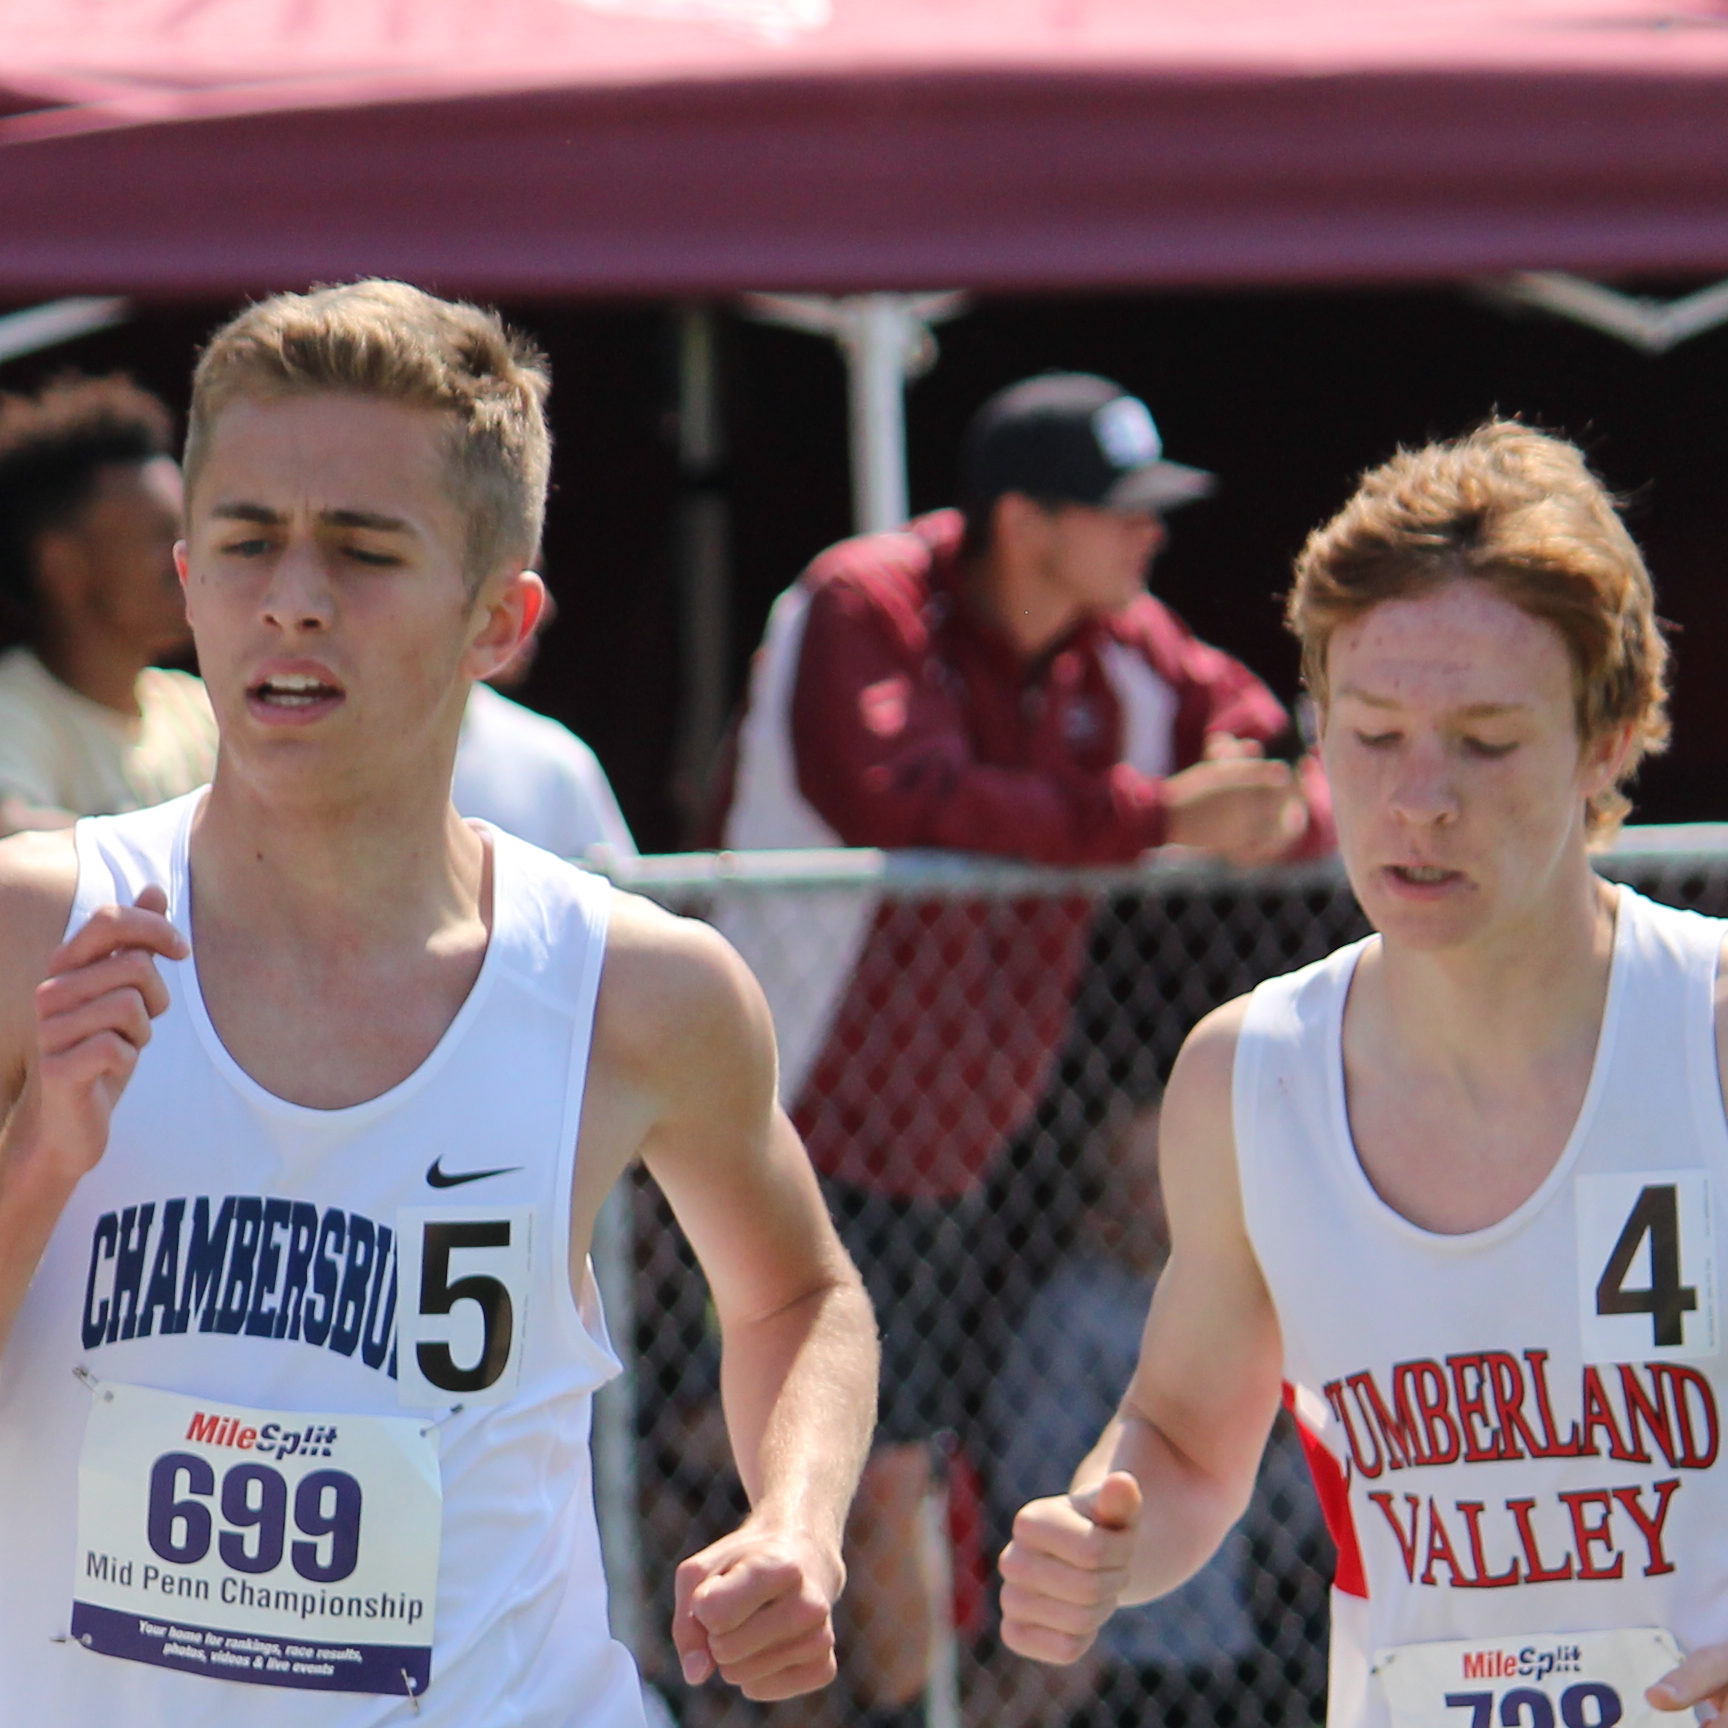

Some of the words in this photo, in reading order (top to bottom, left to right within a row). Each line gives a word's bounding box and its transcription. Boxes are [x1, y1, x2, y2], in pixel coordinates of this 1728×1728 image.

[81, 1195, 398, 1381] CHAMBERSBU
[415, 1220, 513, 1393] 5
[1596, 1183, 1697, 1347] 4
[186, 1411, 338, 1461] MileSplit
[147, 1450, 363, 1584] 699
[1368, 1478, 1680, 1588] VALLEY
[85, 1549, 133, 1587] Mid
[143, 1564, 210, 1600] Penn
[221, 1576, 424, 1625] Championship
[139, 1619, 167, 1637] Your
[210, 1650, 250, 1668] videos
[252, 1654, 264, 1669] &
[292, 1660, 335, 1676] events
[1462, 1645, 1581, 1682] MileSplit
